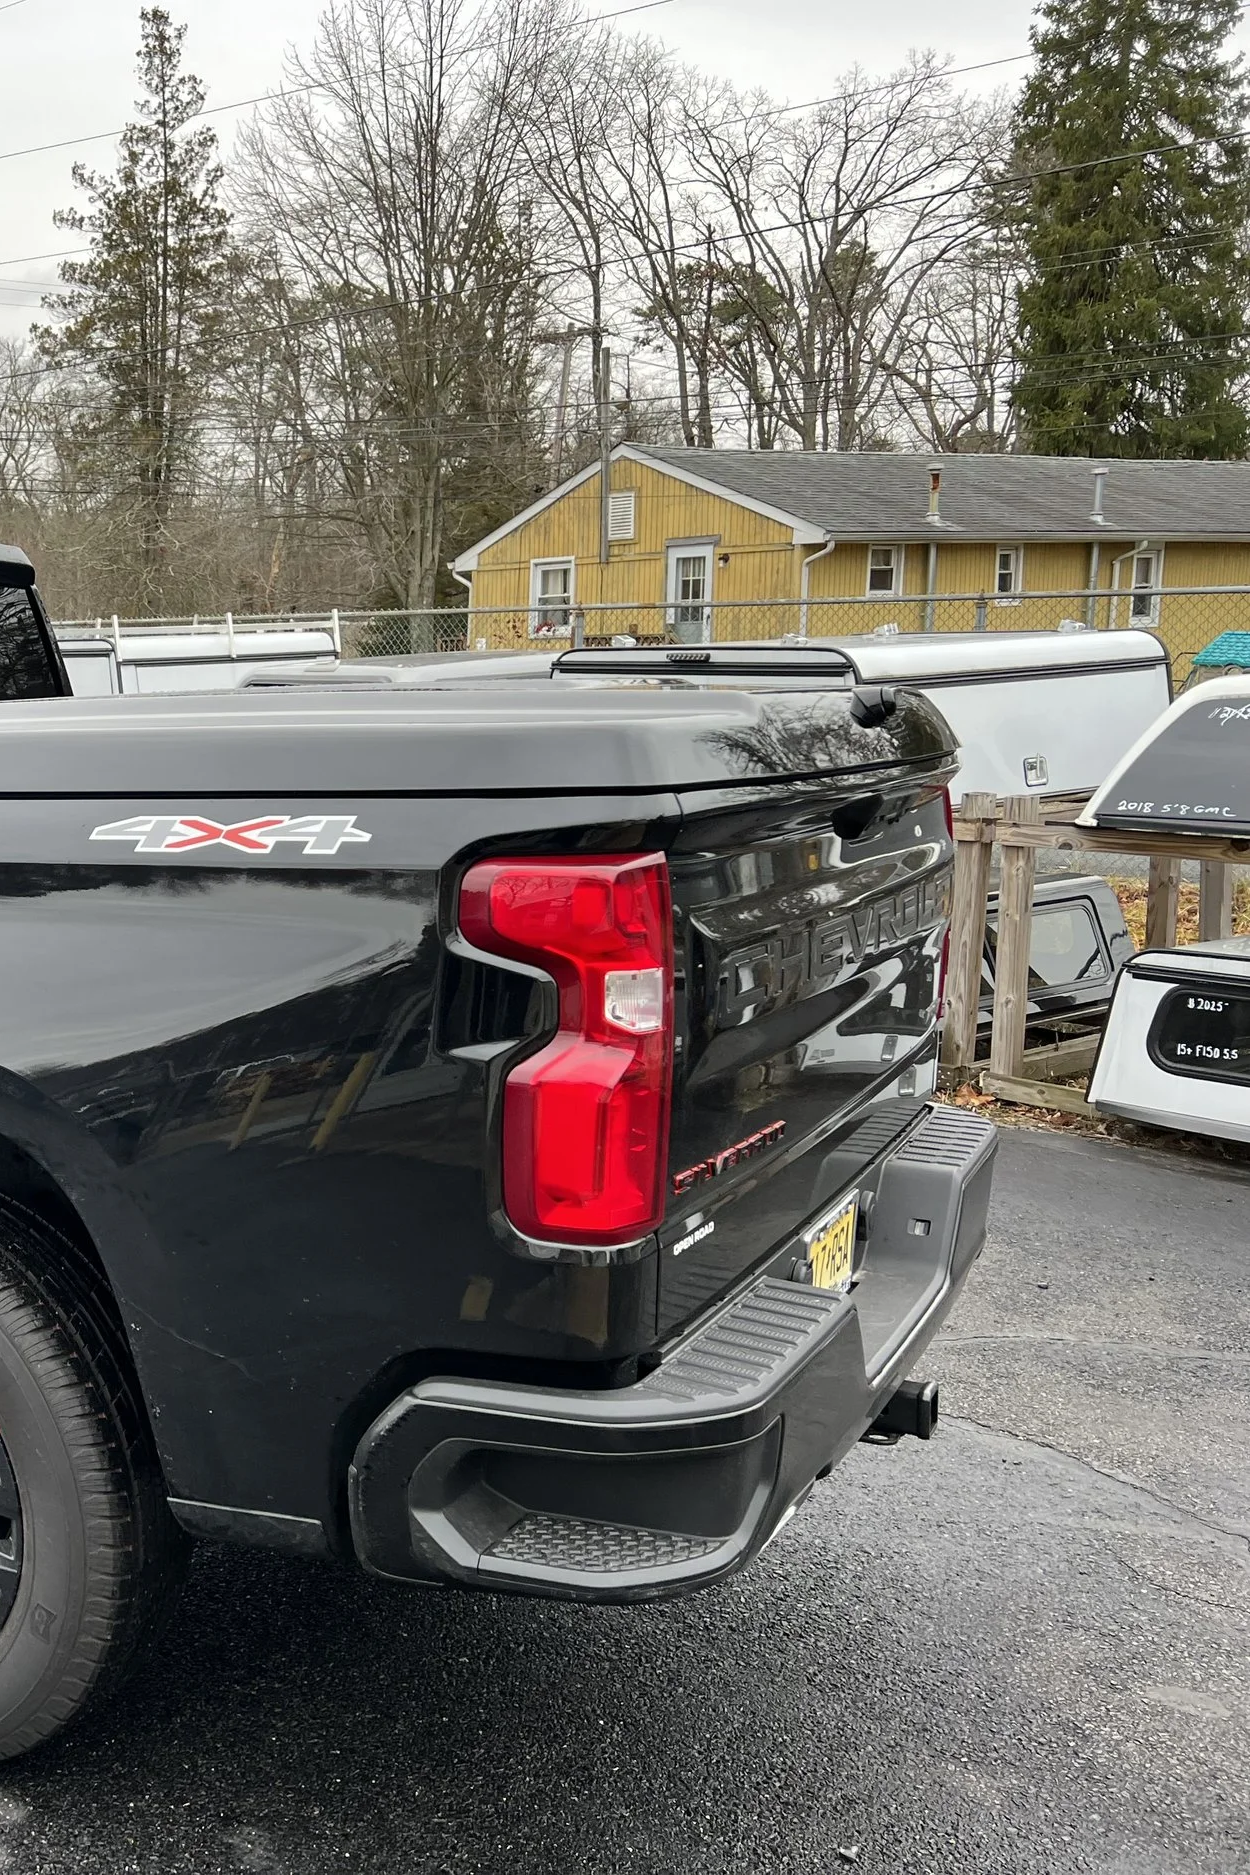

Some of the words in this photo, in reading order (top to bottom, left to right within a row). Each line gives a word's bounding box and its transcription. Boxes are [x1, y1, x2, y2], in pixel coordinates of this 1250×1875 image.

[1117, 799, 1155, 814] 2018
[1193, 804, 1237, 817] GMC
[1195, 1044, 1220, 1059] F150
[673, 1234, 694, 1256] OPEN
[694, 1221, 715, 1243] ROAD
